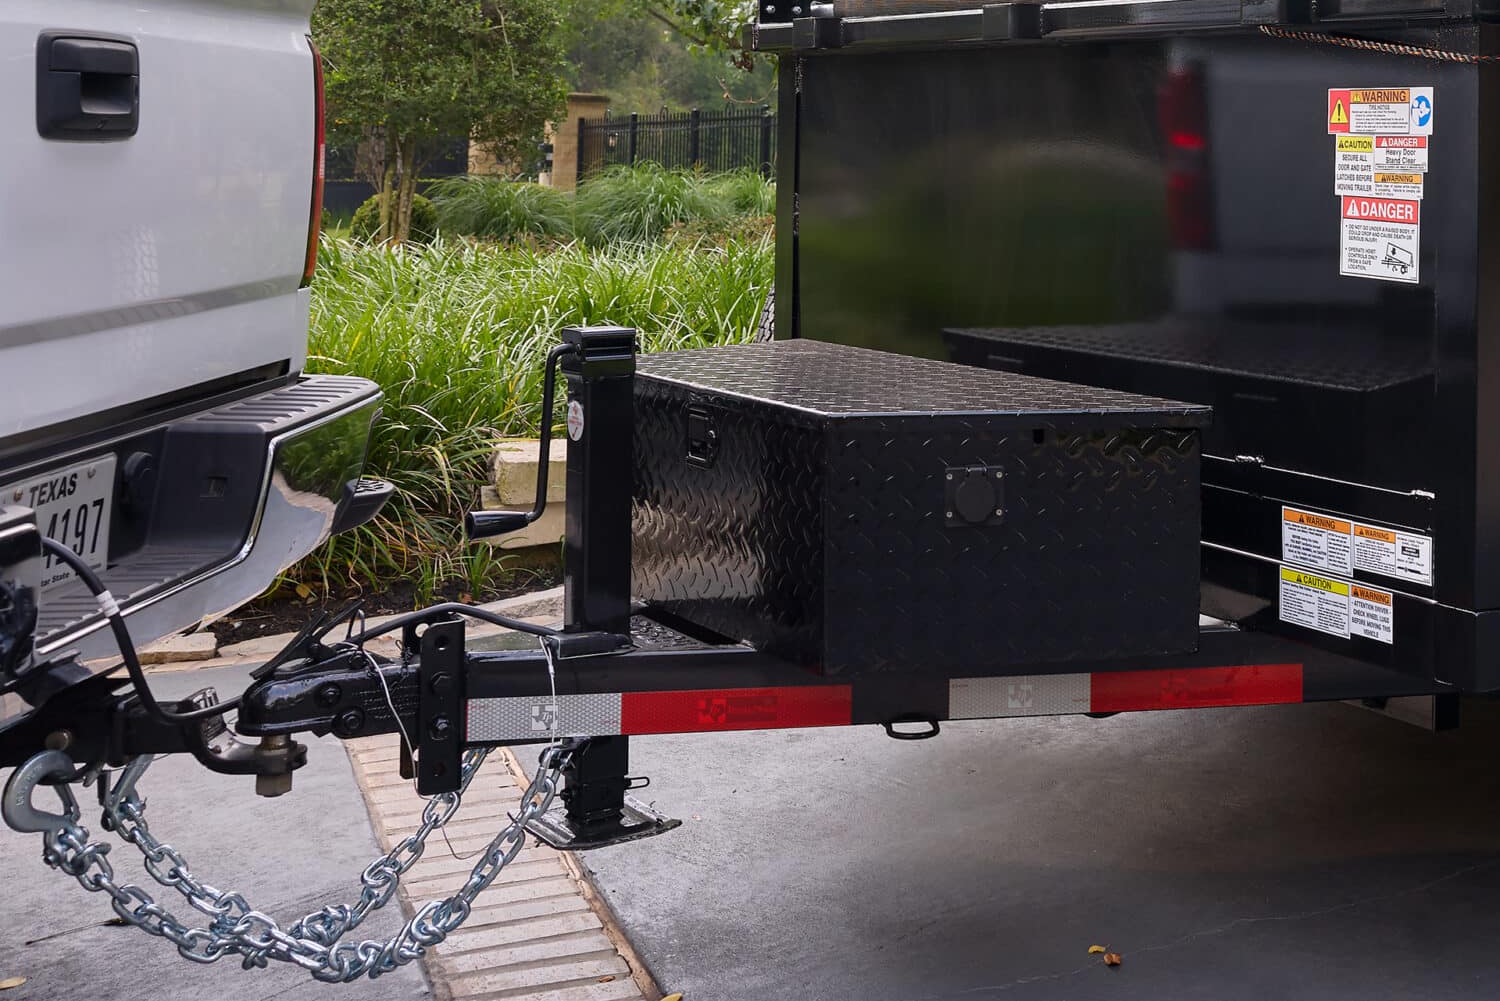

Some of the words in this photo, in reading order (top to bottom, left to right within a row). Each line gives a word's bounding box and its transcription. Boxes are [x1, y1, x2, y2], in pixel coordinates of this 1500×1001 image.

[1362, 91, 1406, 102] WARNING
[1345, 140, 1373, 149] CAUTION
[1388, 137, 1418, 147] DANGER
[1356, 174, 1372, 182] BEFORE
[1386, 175, 1413, 183] WARNING
[1354, 184, 1372, 192] TRAILER
[1361, 201, 1414, 220] DANGER
[29, 473, 78, 508] TEXAS
[1306, 516, 1336, 529] WARNING
[43, 498, 104, 569] 4197
[1365, 530, 1389, 540] WARNING
[52, 571, 70, 584] State
[1304, 576, 1332, 589] CAUTION
[1359, 588, 1390, 604] WARNING
[1354, 600, 1374, 610] ATTENTION
[1353, 609, 1365, 617] CHECK
[1352, 617, 1366, 626] BEFORE
[1367, 620, 1381, 630] MOVING
